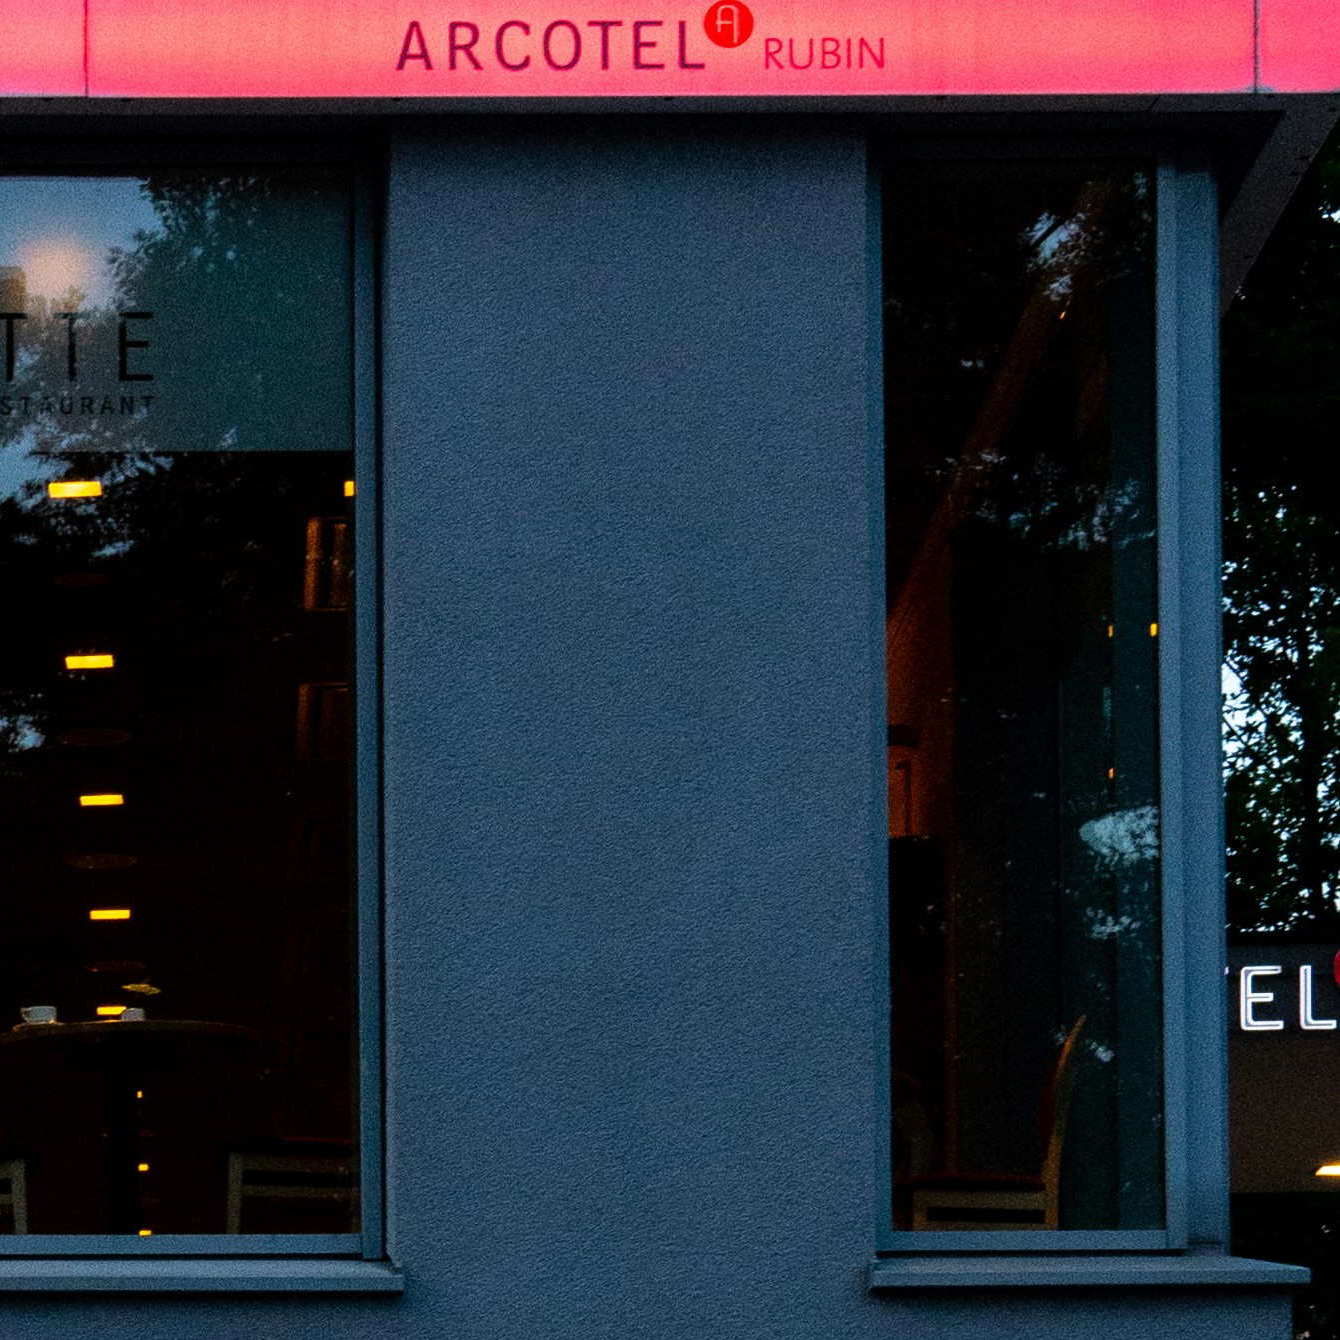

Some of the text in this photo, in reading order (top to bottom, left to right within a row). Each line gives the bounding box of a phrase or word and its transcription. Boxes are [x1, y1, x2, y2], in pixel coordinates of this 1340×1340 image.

[396, 20, 706, 71] ARCOTEL
[764, 37, 886, 70] RUBIN
[1223, 962, 1338, 1032] EL
